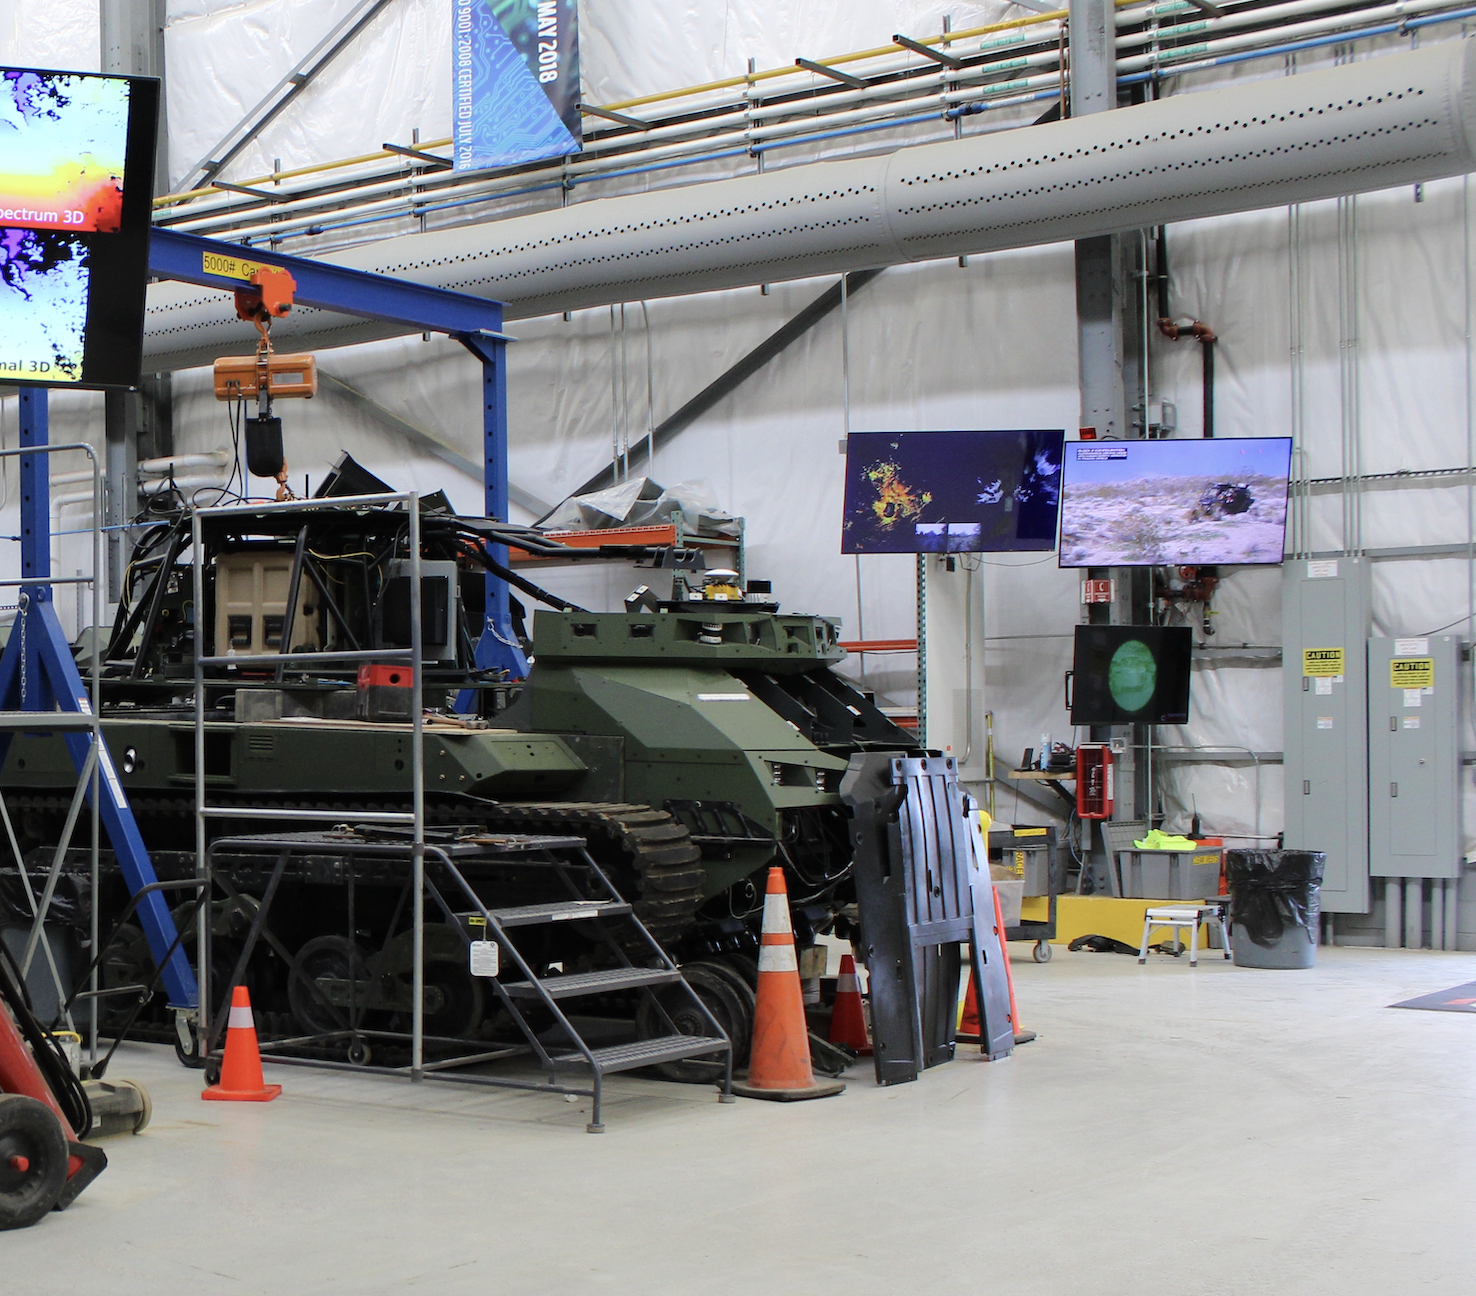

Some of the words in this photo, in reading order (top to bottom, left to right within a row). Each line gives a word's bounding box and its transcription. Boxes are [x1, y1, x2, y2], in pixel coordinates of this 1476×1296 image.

[537, 0, 558, 37] MAY
[538, 40, 559, 84] 2018
[458, 69, 473, 119] CERTIFIED
[457, 121, 473, 144] JULY
[458, 145, 473, 170] 2016
[63, 210, 85, 224] 3D
[204, 255, 236, 273] 5000#
[29, 360, 51, 373] 3D
[1306, 651, 1341, 660] CAUTION
